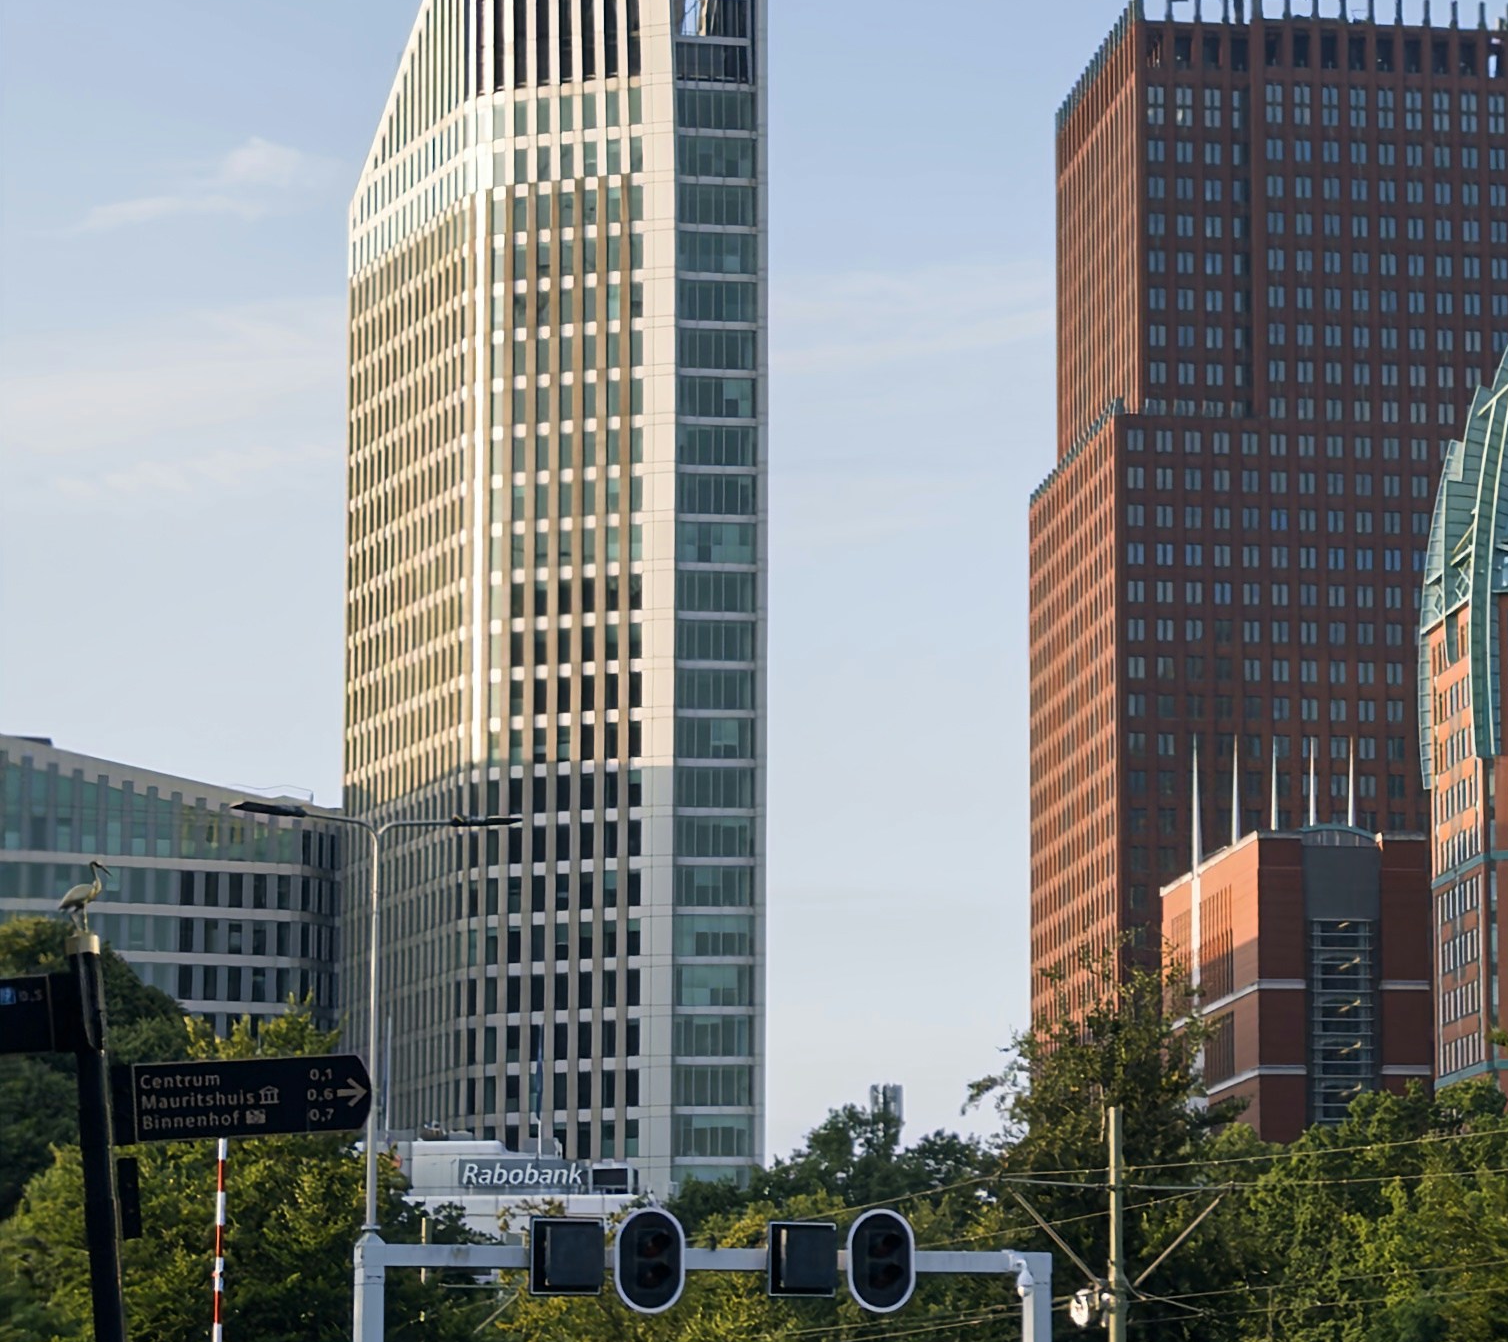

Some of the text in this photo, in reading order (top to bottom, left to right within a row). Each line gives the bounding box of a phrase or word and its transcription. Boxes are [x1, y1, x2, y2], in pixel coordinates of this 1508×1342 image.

[140, 1068, 333, 1089] Centrum 0,1
[141, 1088, 334, 1110] Mauritshuis 0,6
[143, 1108, 335, 1130] Binnenhof 0,7
[462, 1163, 583, 1186] Rabobank
